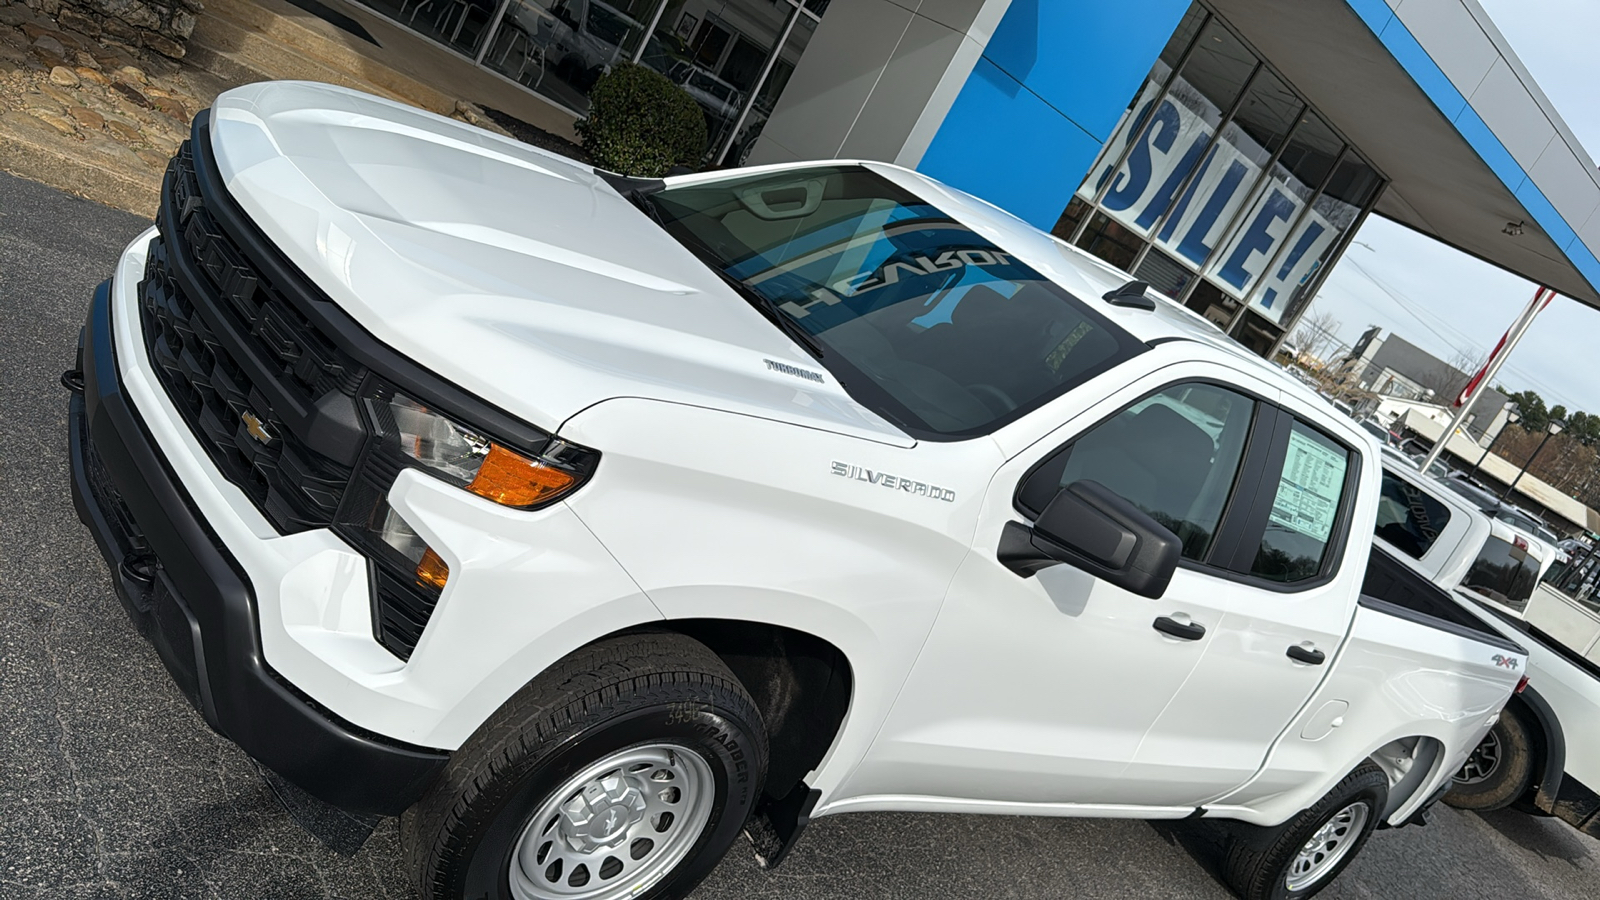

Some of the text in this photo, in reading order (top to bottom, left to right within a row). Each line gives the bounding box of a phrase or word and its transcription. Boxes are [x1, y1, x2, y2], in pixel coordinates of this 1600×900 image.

[1096, 98, 1325, 309] SALE!
[763, 359, 825, 384] TURBOMAX
[830, 460, 957, 502] SILVERADO
